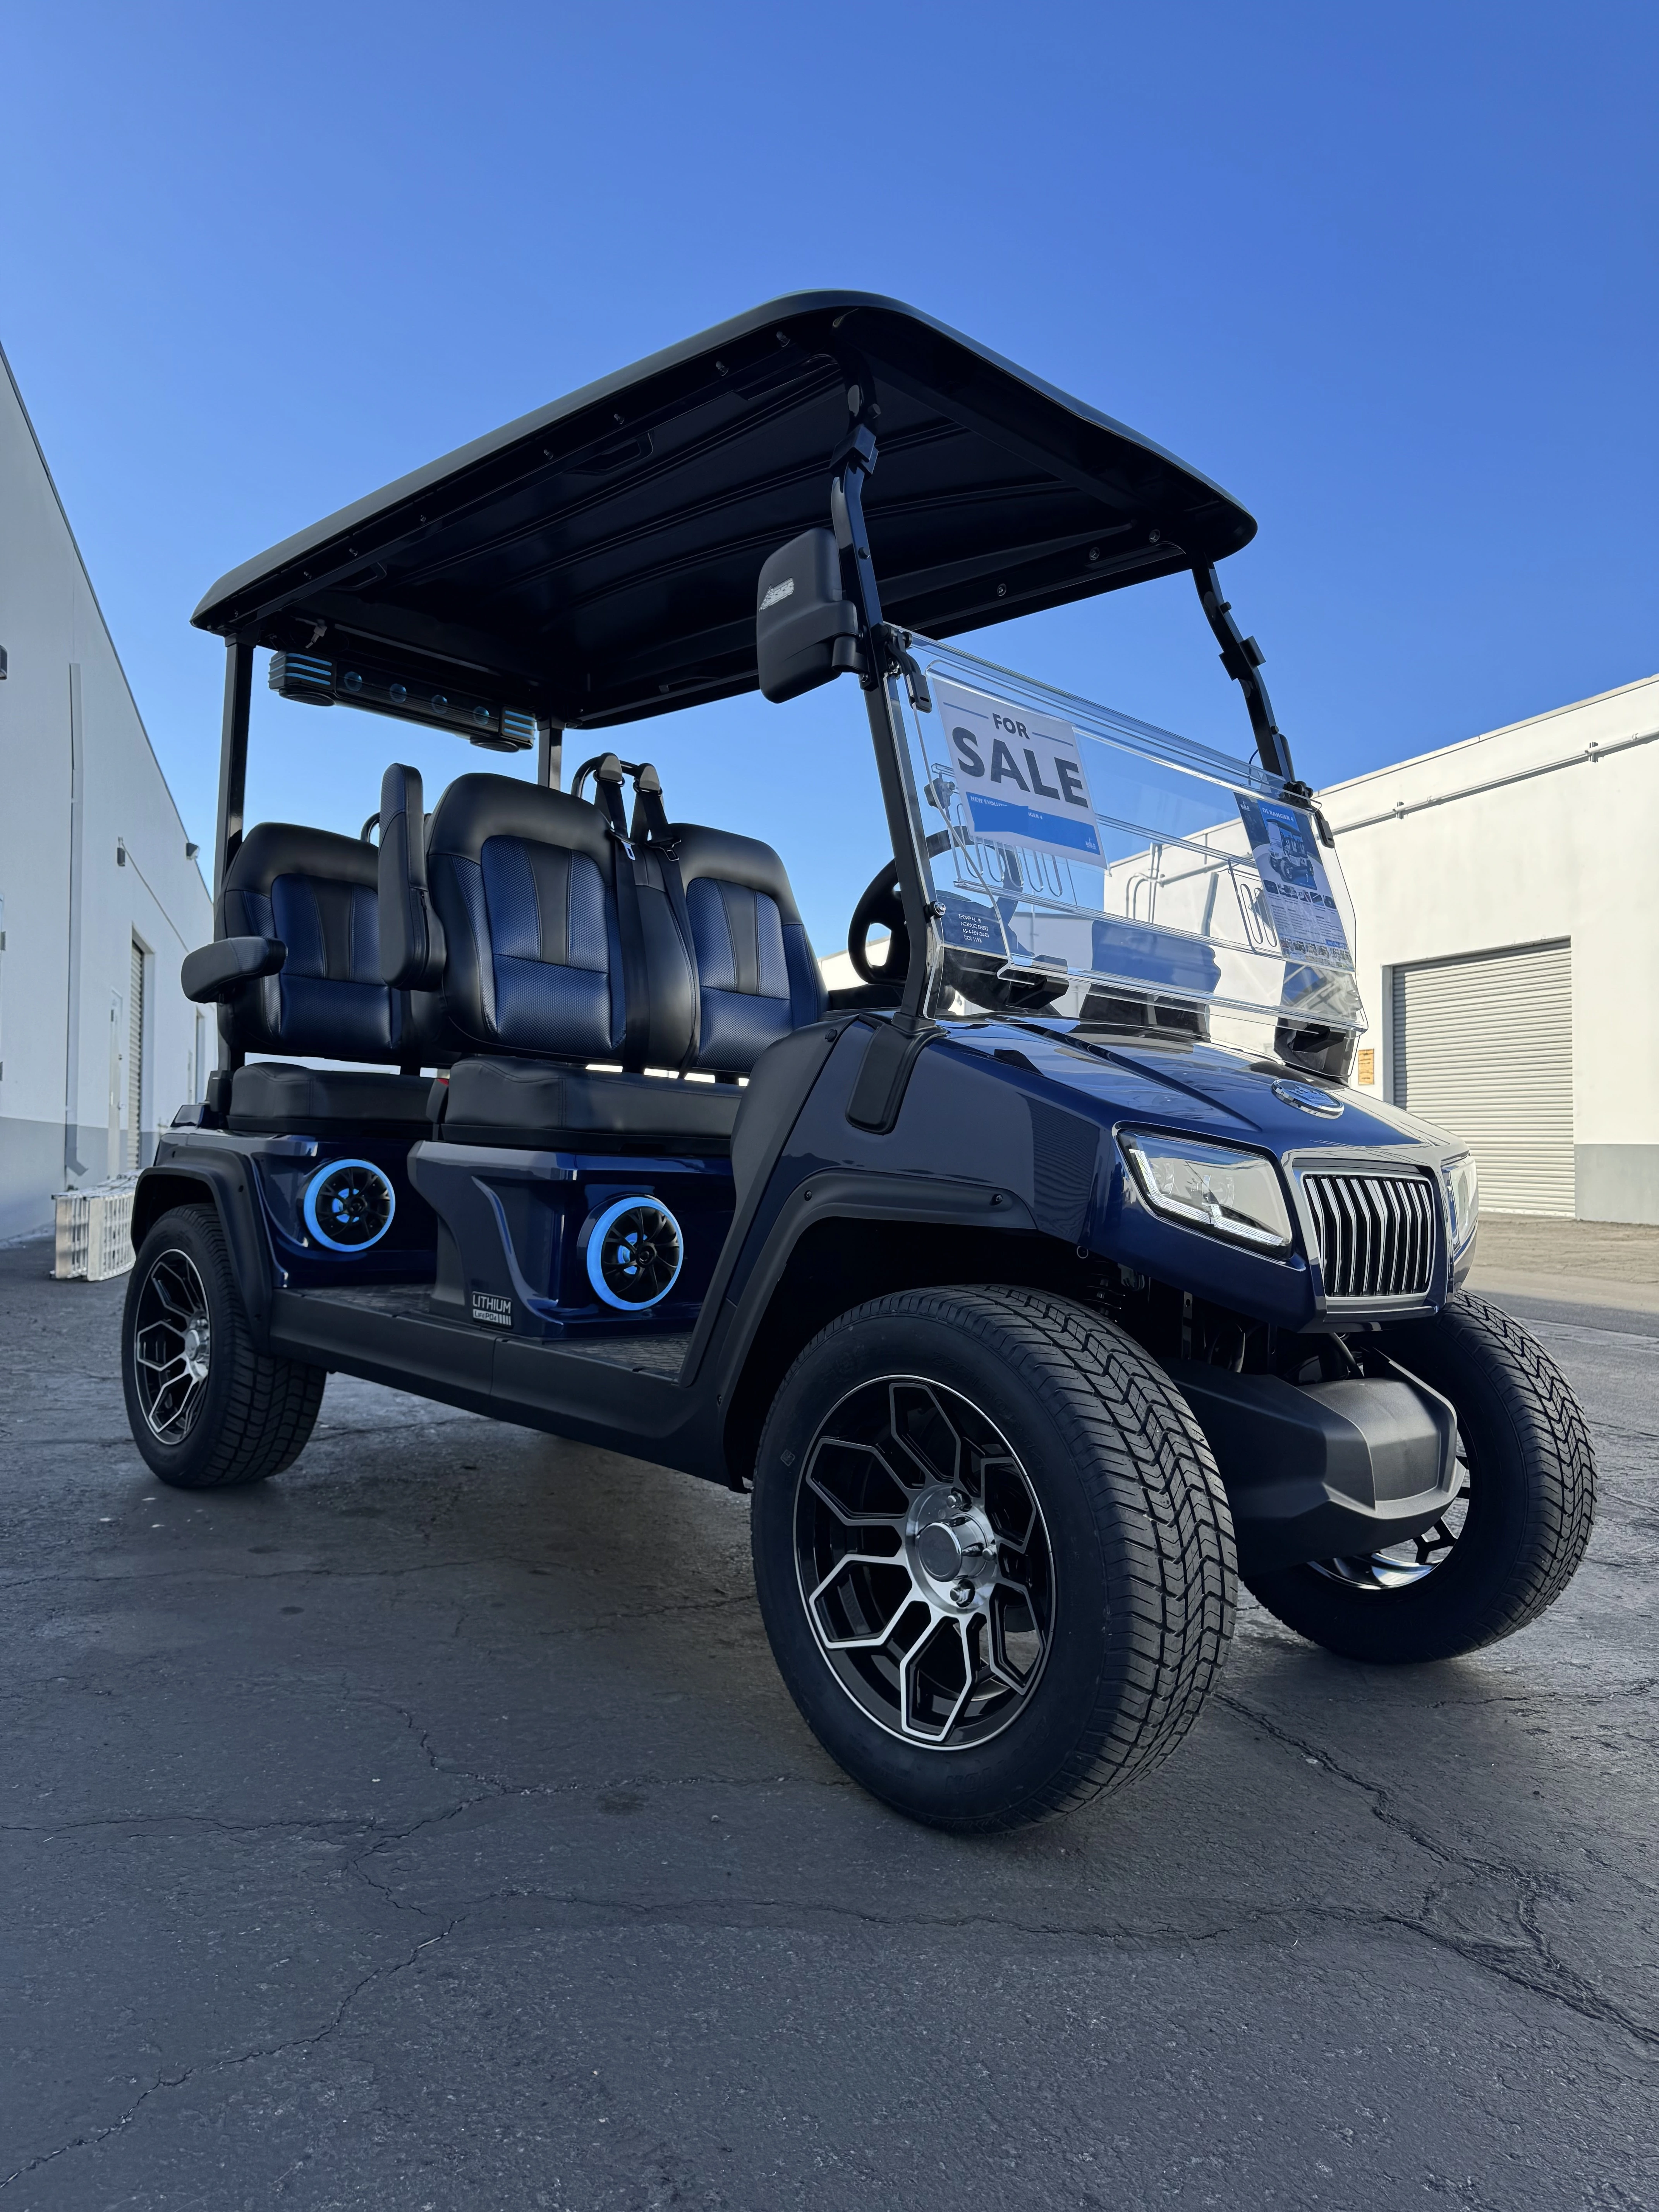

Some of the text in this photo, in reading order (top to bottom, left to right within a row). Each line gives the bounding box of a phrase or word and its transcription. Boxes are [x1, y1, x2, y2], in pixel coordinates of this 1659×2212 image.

[992, 713, 1030, 740] FOR
[952, 727, 1089, 808] SALE
[1269, 810, 1290, 821] RANGER
[473, 1295, 511, 1314] LITHIUM
